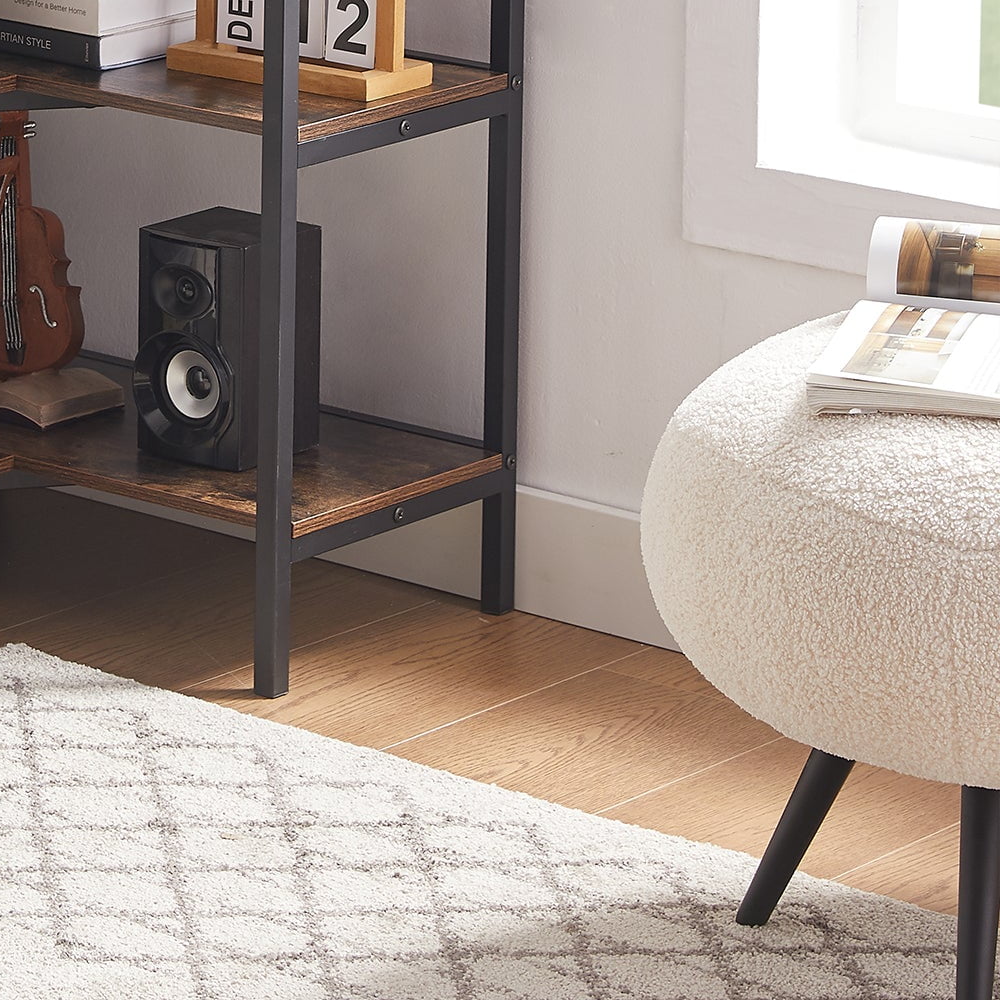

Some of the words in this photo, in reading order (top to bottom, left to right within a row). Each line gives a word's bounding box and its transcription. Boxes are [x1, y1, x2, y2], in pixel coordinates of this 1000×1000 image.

[35, 0, 44, 8] for
[49, 2, 68, 12] Better
[68, 6, 87, 17] Home
[26, 36, 52, 50] STYLE
